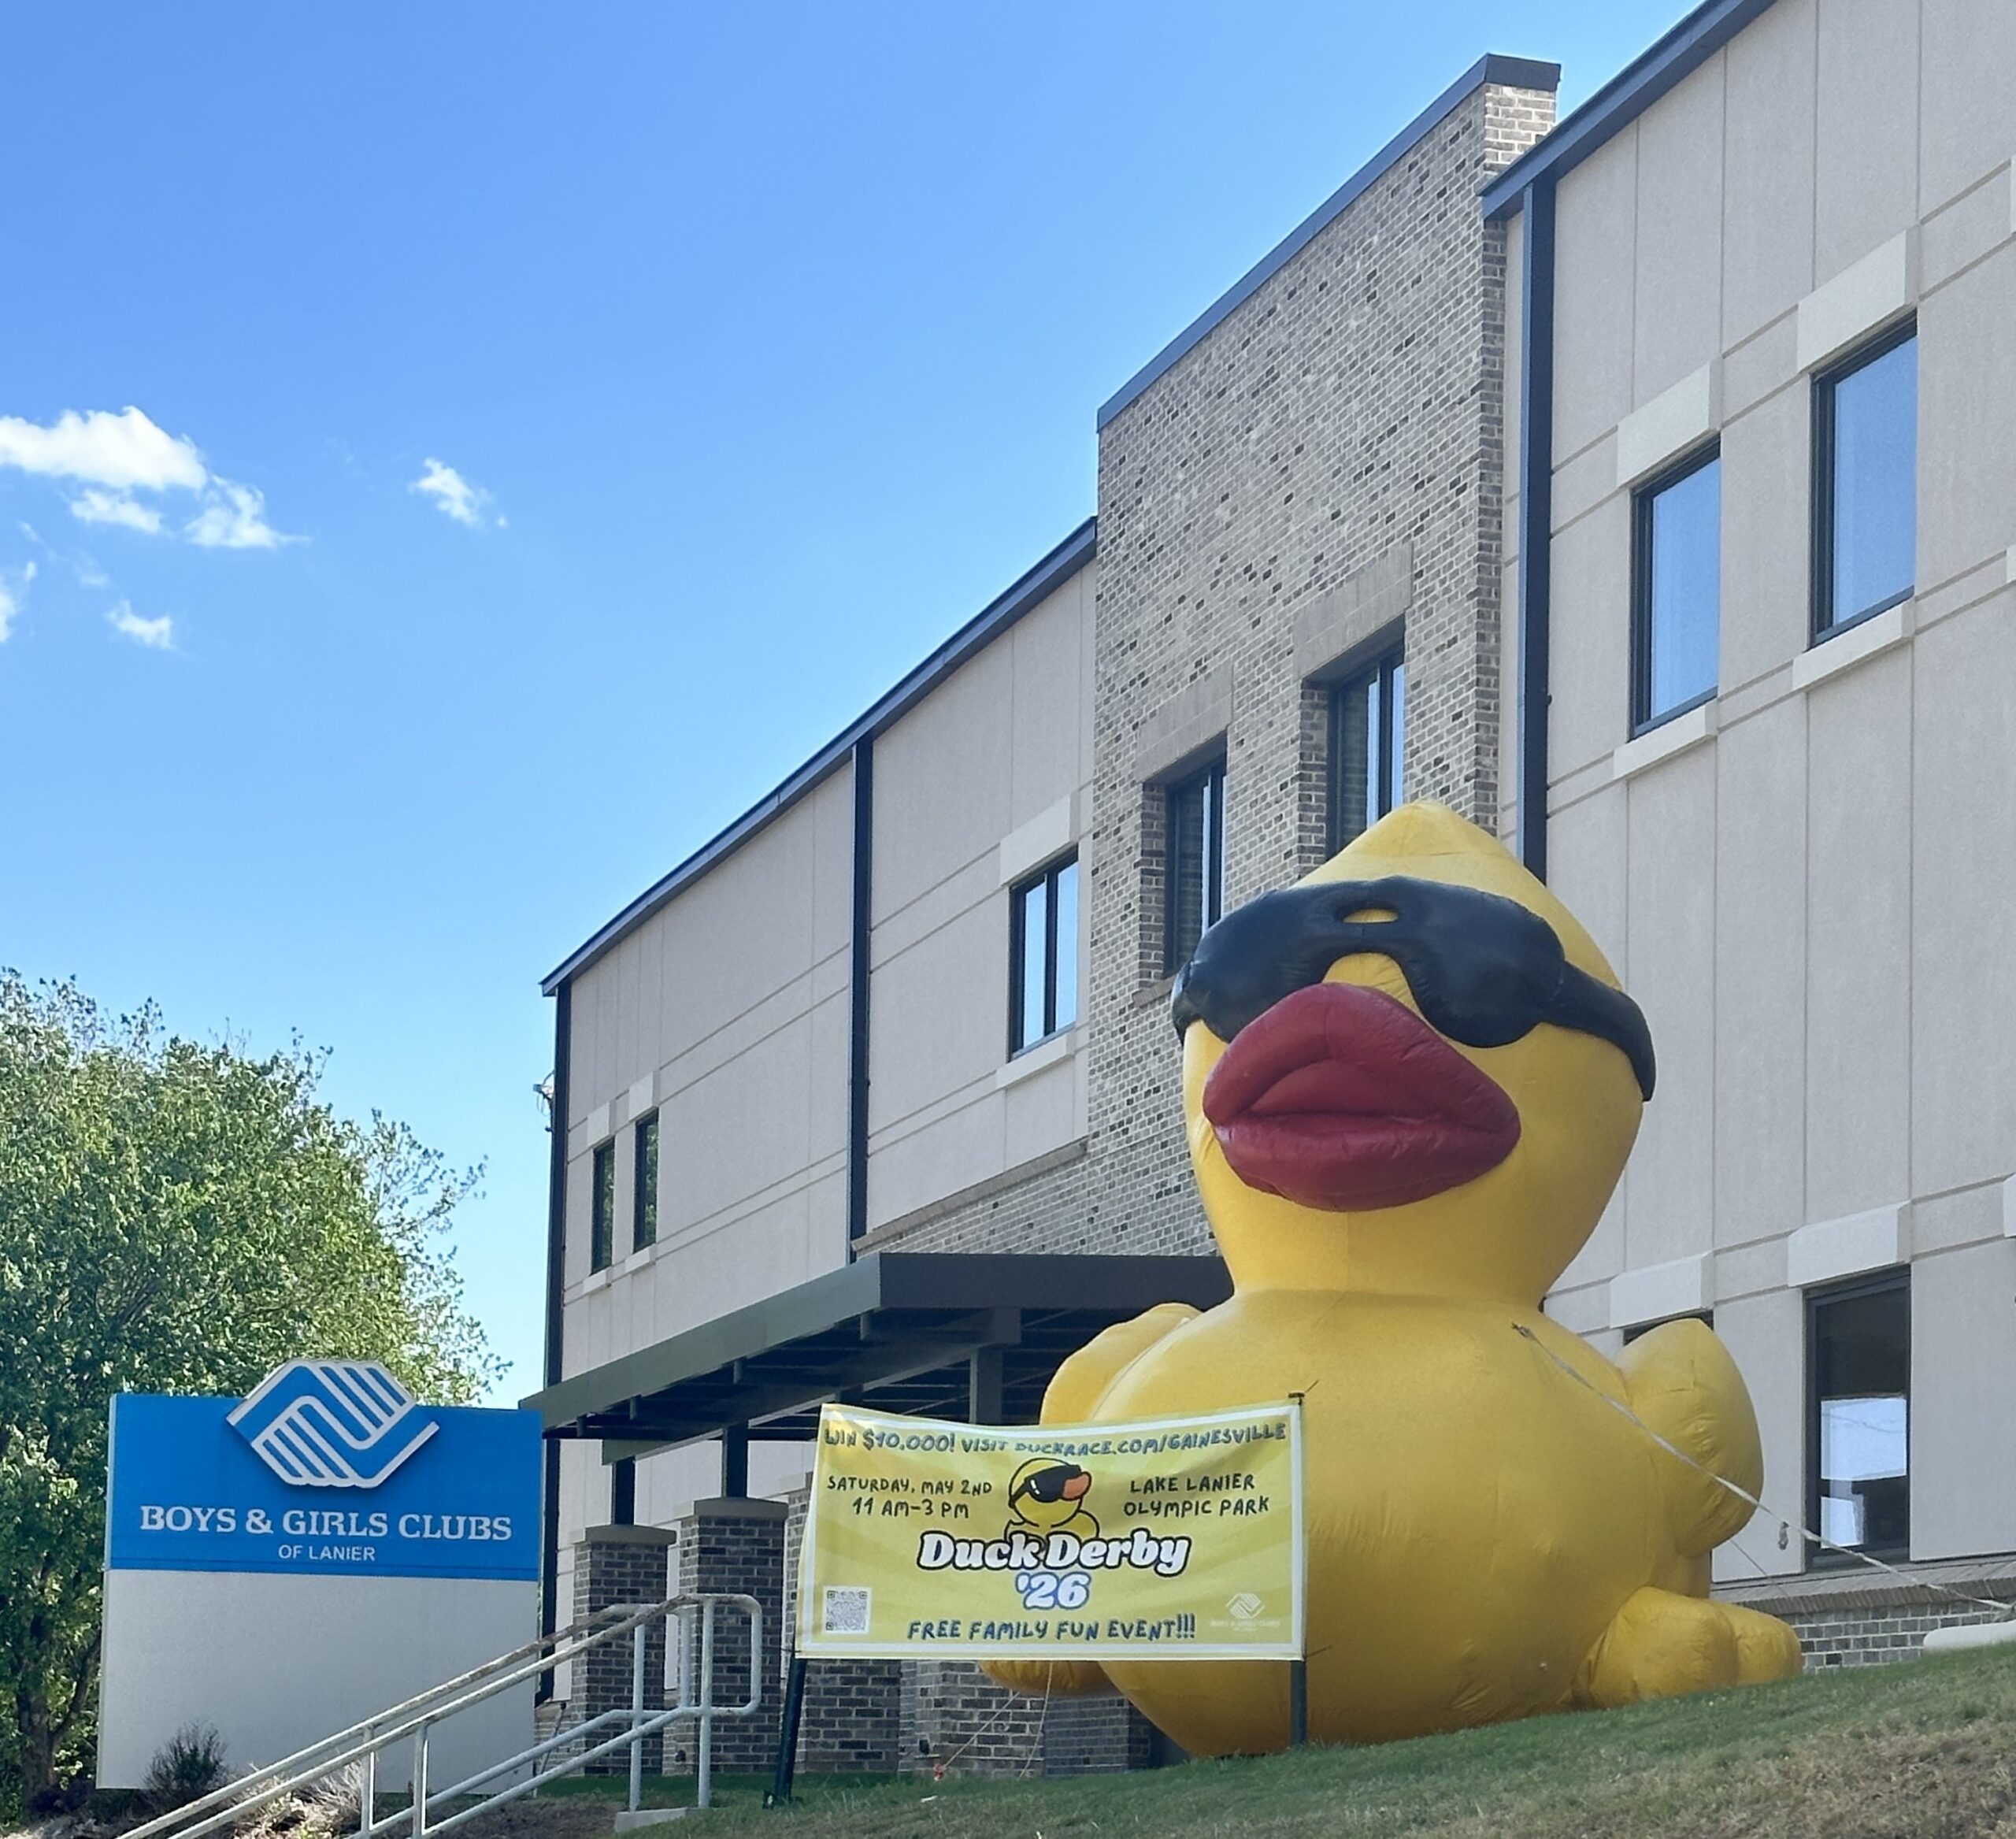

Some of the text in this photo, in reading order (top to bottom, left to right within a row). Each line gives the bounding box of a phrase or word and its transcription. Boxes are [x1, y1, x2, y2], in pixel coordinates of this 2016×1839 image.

[824, 1428, 856, 1447] WIN
[961, 1438, 1009, 1452] VISIT
[1014, 1423, 1286, 1456] DUCKRACE.COM/GAINESVILLE
[827, 1475, 992, 1496] SATURDAY, MAY 2ND
[1131, 1474, 1255, 1492] LAKE LANIER
[853, 1497, 873, 1515] 11
[941, 1502, 969, 1518] PM
[1124, 1496, 1269, 1518] OLYMPIC PARK
[140, 1505, 513, 1541] BOYS & GIRLS CLUBS
[278, 1544, 376, 1562] OF LANIER
[917, 1528, 1191, 1577] Duck Derby
[1016, 1573, 1091, 1609] '26
[906, 1613, 1196, 1641] FREE FAMILY FUN EVENT!!!
